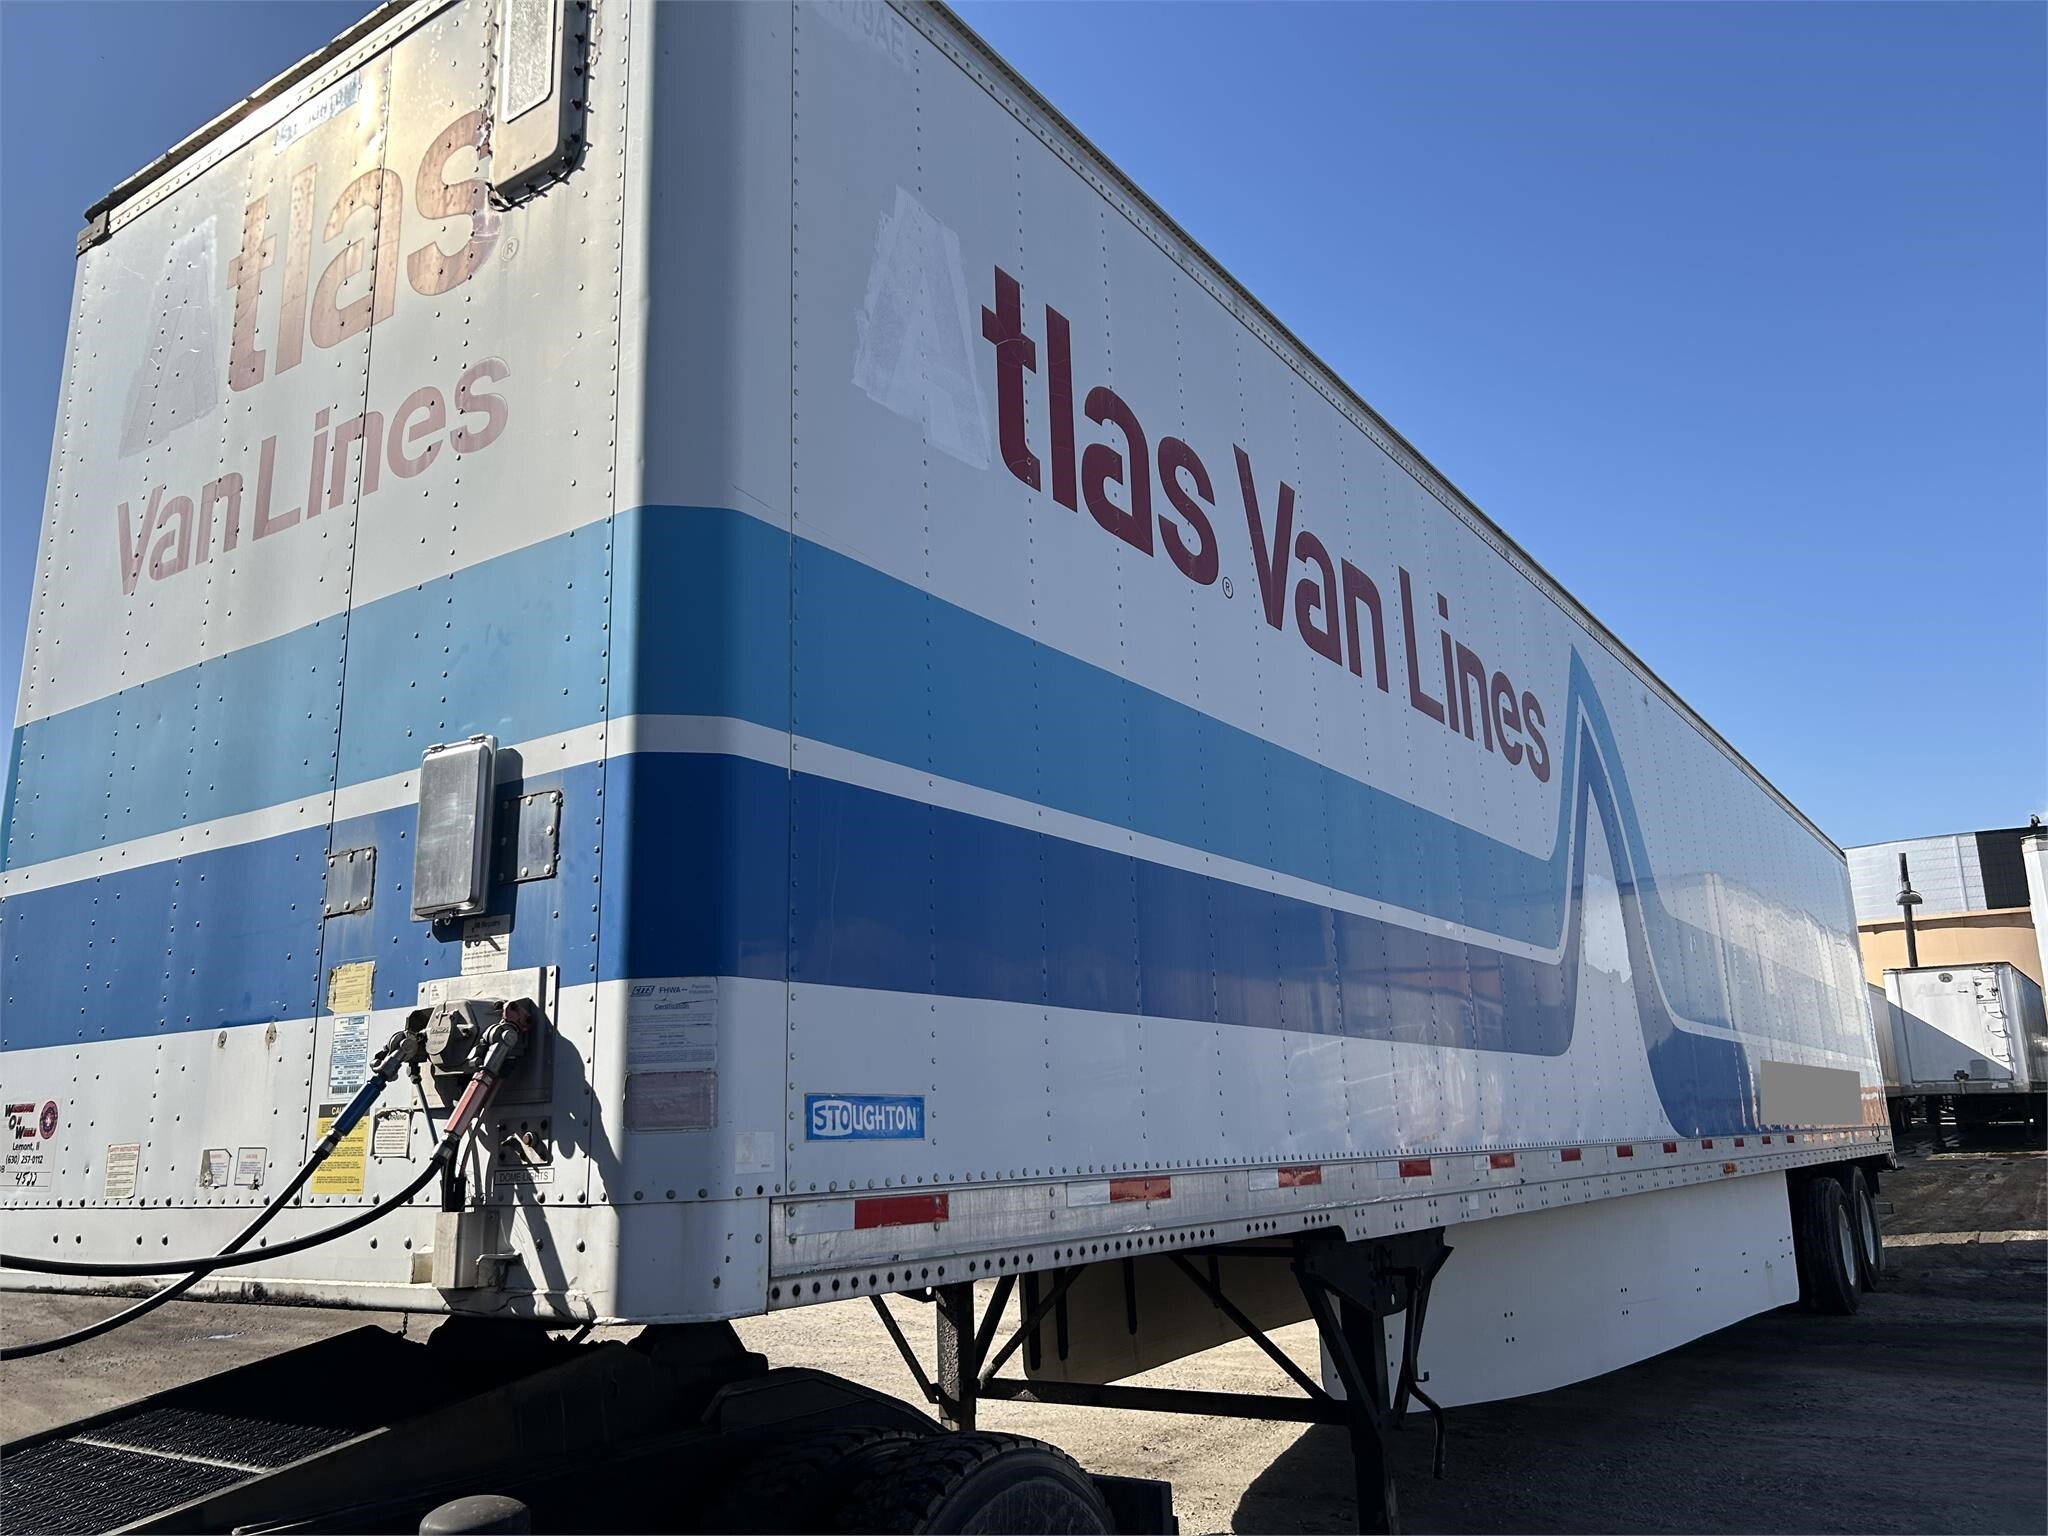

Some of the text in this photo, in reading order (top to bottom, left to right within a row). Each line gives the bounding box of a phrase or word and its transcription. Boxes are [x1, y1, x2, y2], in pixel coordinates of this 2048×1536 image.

[117, 356, 511, 595] Van Lines
[1233, 443, 1389, 693] Van
[1399, 566, 1550, 783] Lines
[814, 1104, 918, 1131] STOUGHTON
